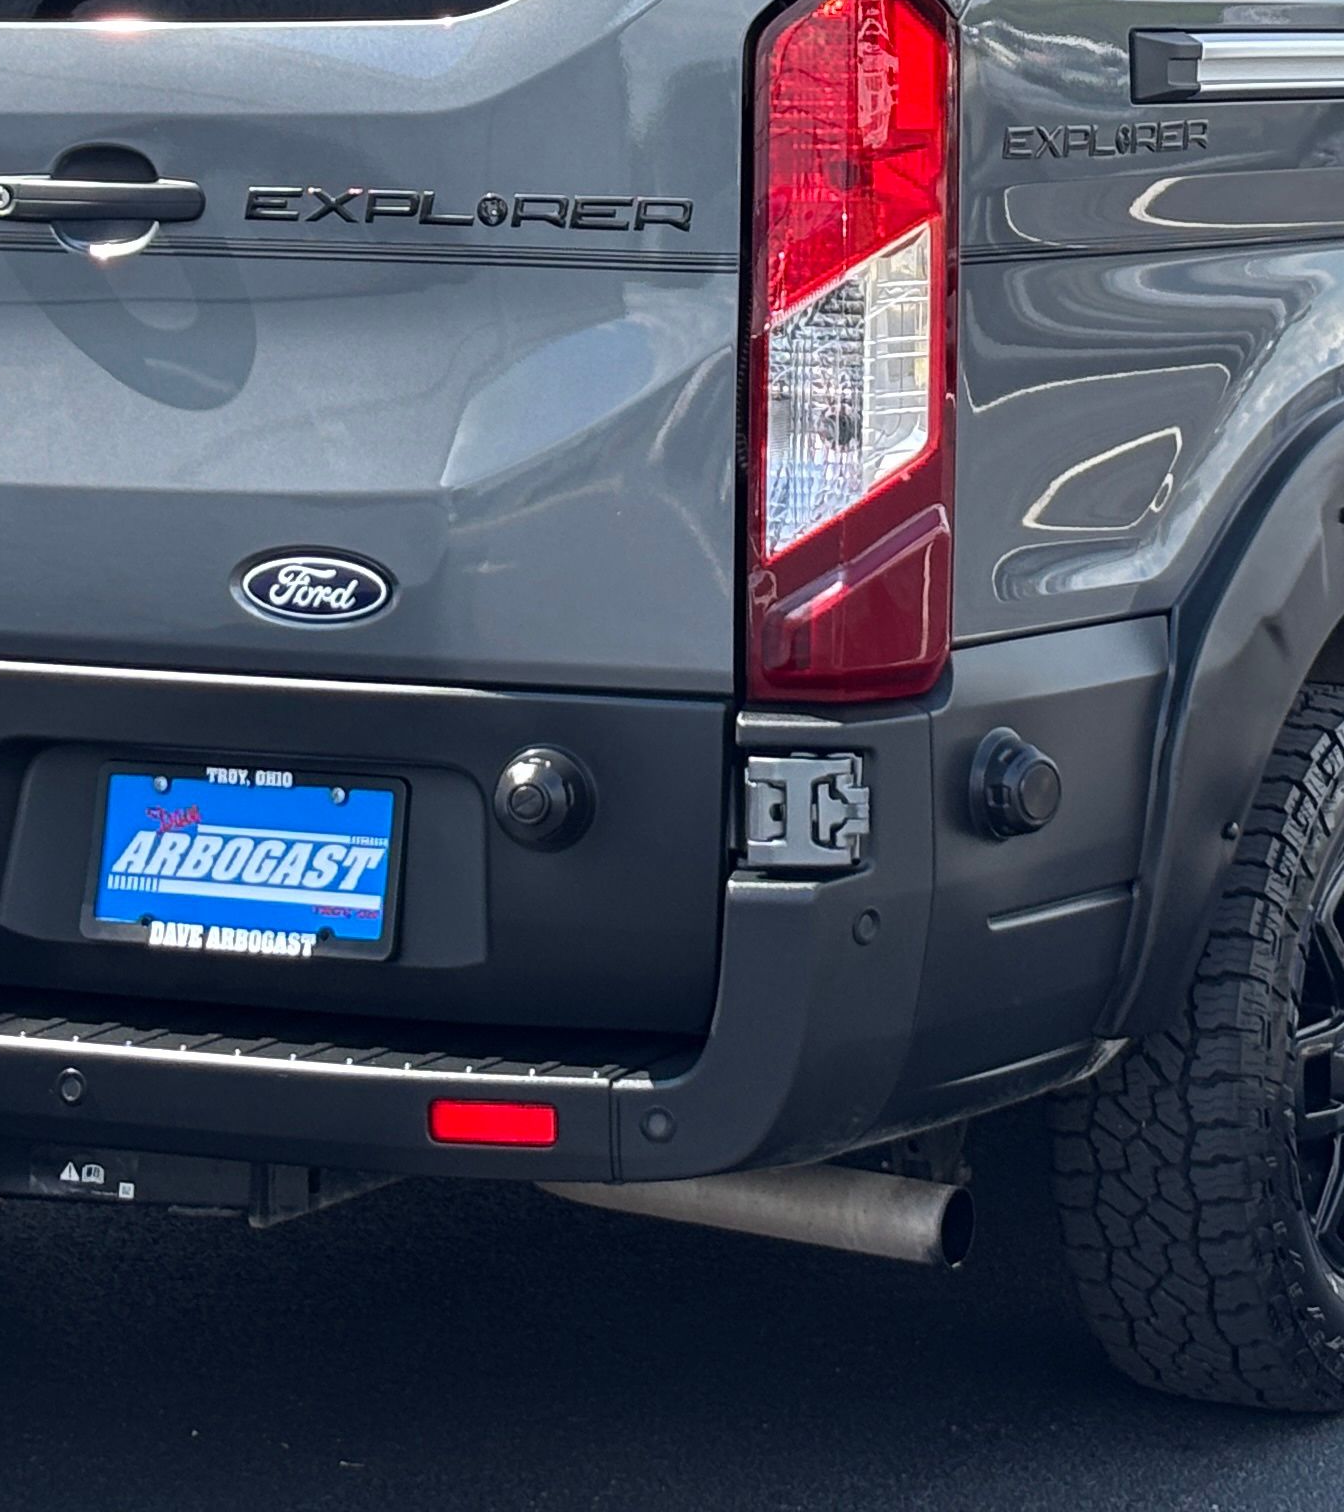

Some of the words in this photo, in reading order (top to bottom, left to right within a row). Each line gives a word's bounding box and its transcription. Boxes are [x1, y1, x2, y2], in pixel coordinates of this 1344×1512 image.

[1002, 119, 1209, 160] EXPLORER
[244, 185, 694, 232] EXPLORER
[269, 564, 359, 609] Ford
[206, 767, 251, 787] TROY,
[255, 770, 294, 788] OHIO
[112, 831, 386, 891] ARBOGAST
[149, 921, 204, 949] DAVE
[205, 926, 317, 957] ARBOGAST
